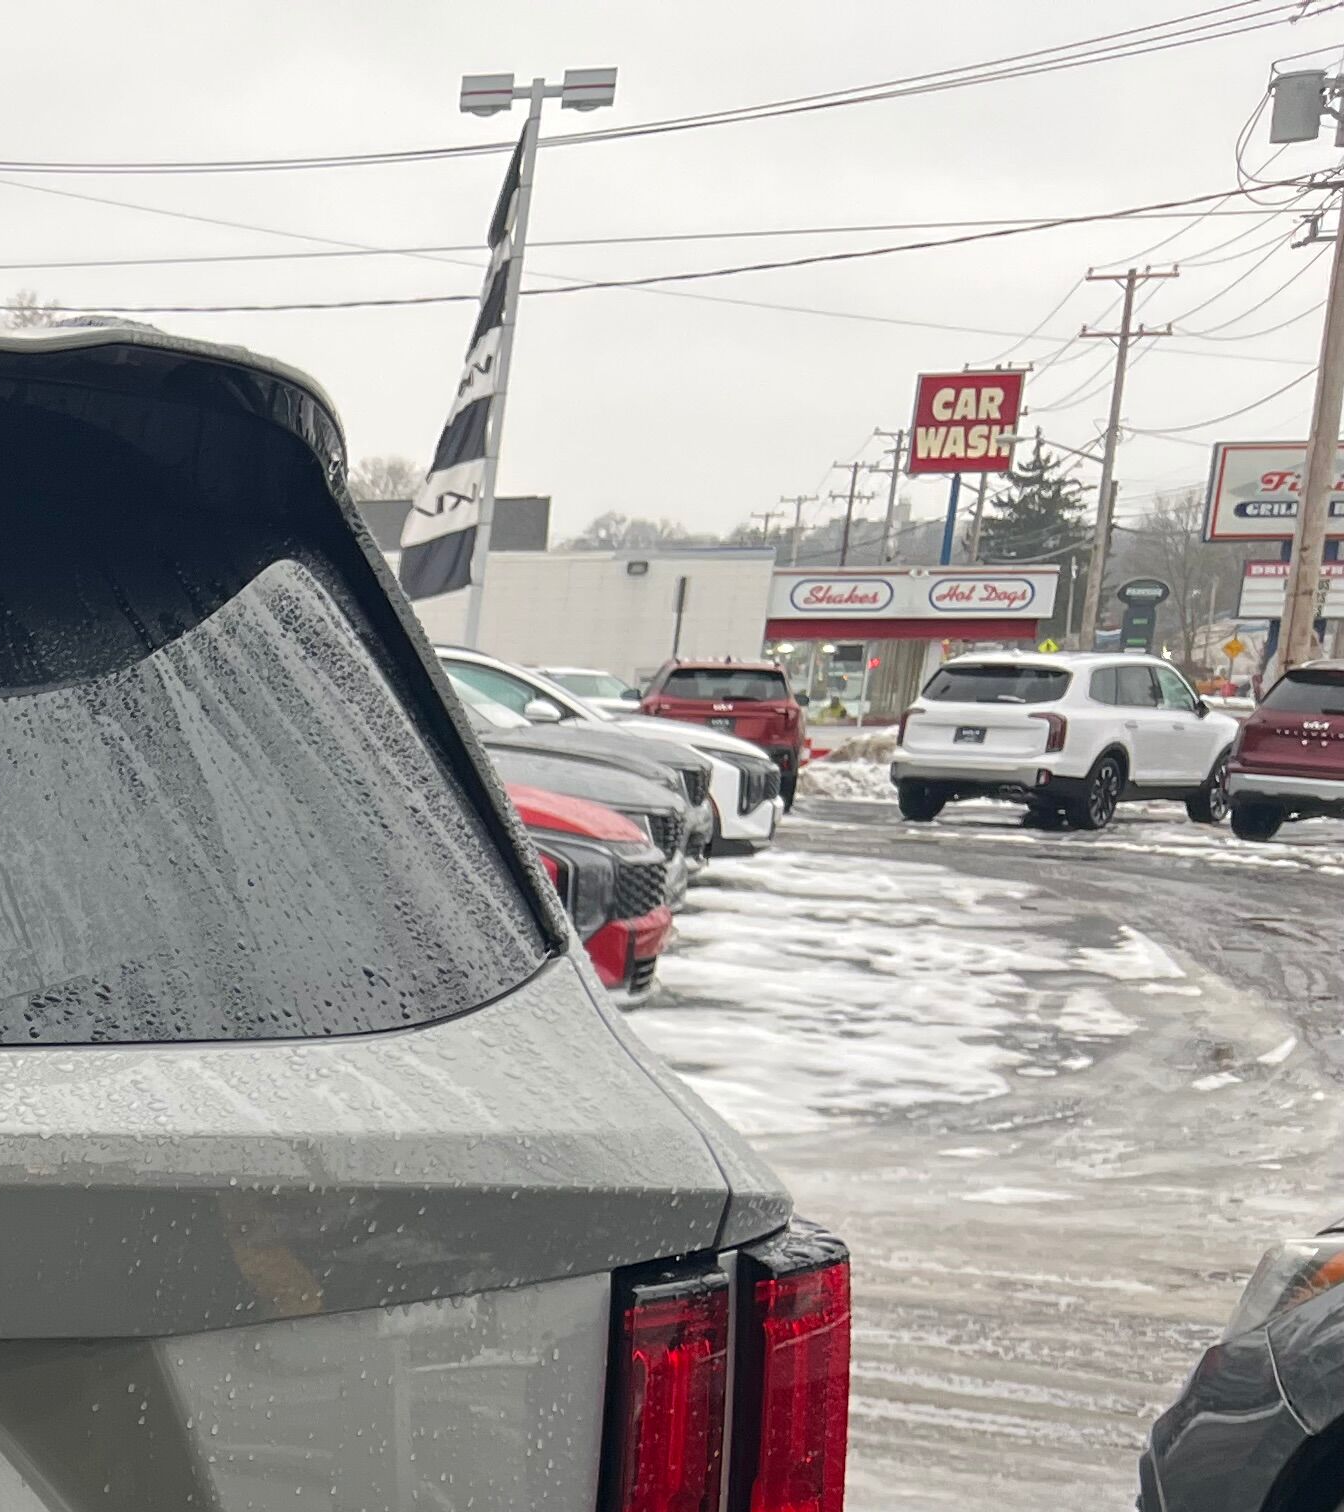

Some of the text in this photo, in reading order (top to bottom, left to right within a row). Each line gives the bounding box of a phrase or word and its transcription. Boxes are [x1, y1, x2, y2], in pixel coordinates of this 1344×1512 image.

[932, 387, 1004, 421] CAR
[916, 424, 1013, 459] WASH
[803, 585, 879, 604] Shakes
[936, 584, 1028, 608] Hot Dogs
